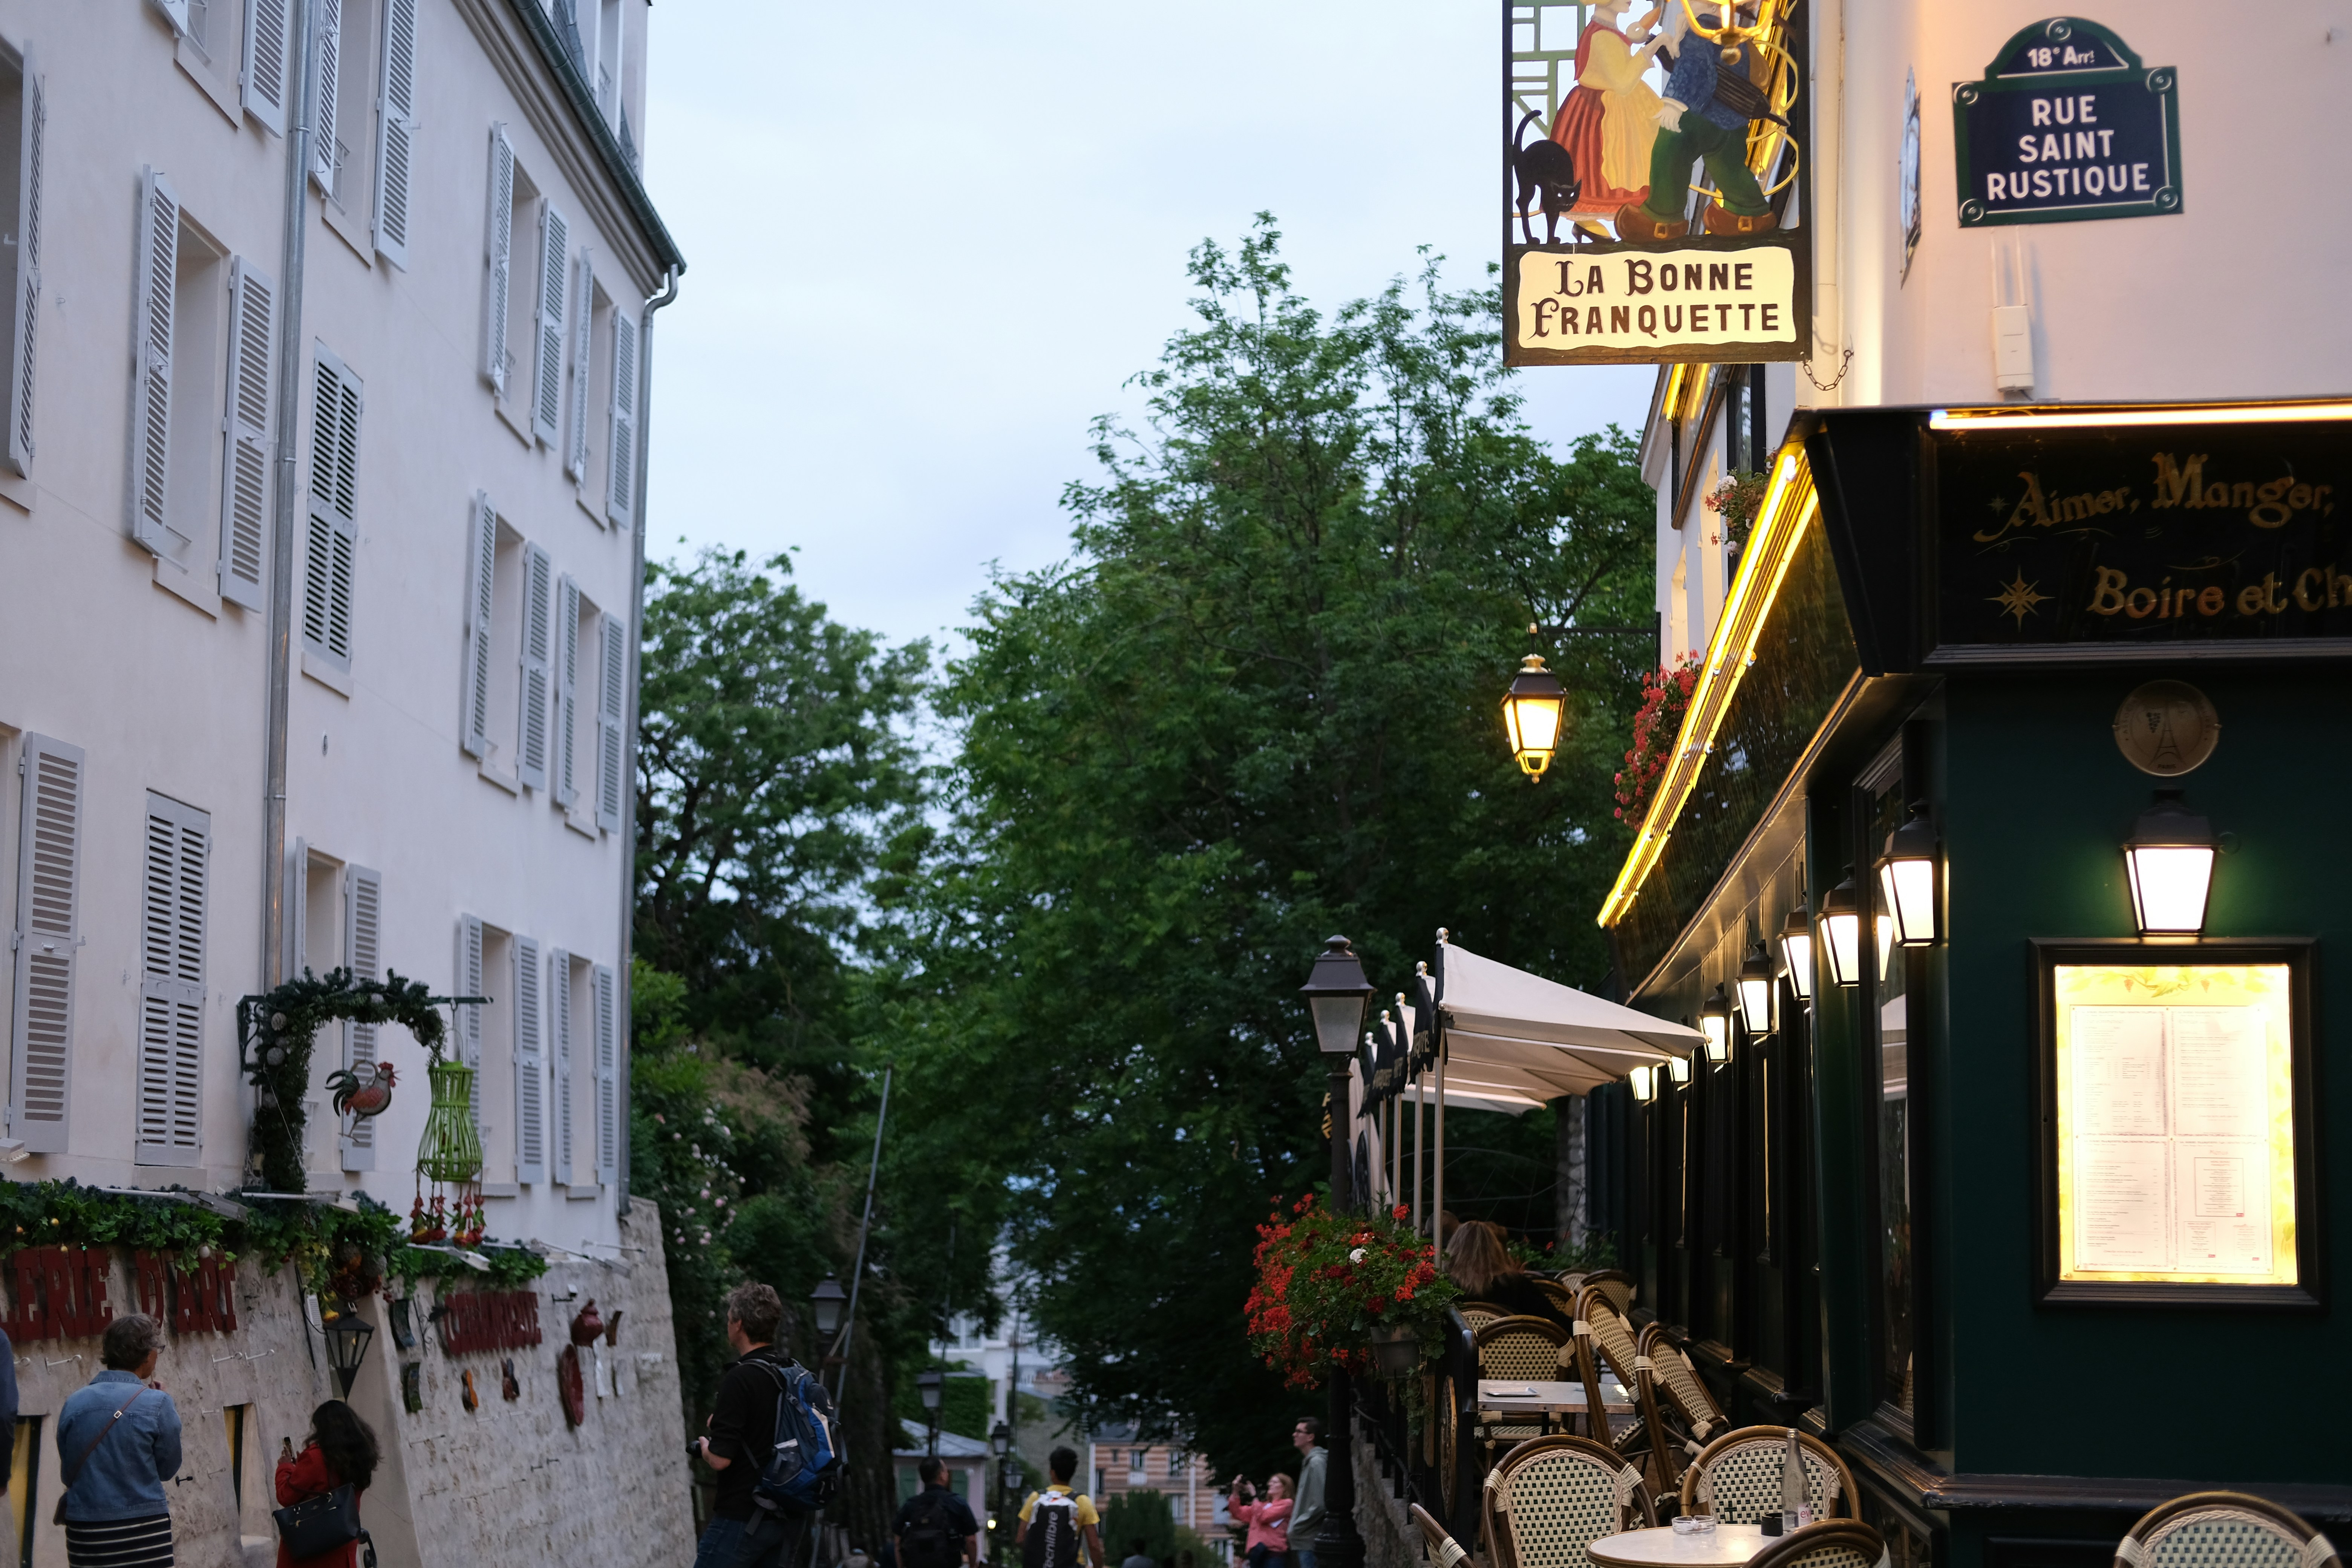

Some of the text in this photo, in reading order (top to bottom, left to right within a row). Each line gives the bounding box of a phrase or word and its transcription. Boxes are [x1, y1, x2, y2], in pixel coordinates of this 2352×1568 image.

[2032, 95, 2098, 126] RUE
[2018, 129, 2115, 163] SAINT
[1987, 163, 2151, 201] RUSTIQUE
[1554, 259, 1753, 297] LA BONNE
[1527, 297, 1780, 340] FRANQUETTE
[1972, 452, 2334, 543] Aimer, Manger,
[2086, 566, 2226, 619] Boire
[2236, 571, 2288, 616] et
[0, 1248, 113, 1343] ERIE
